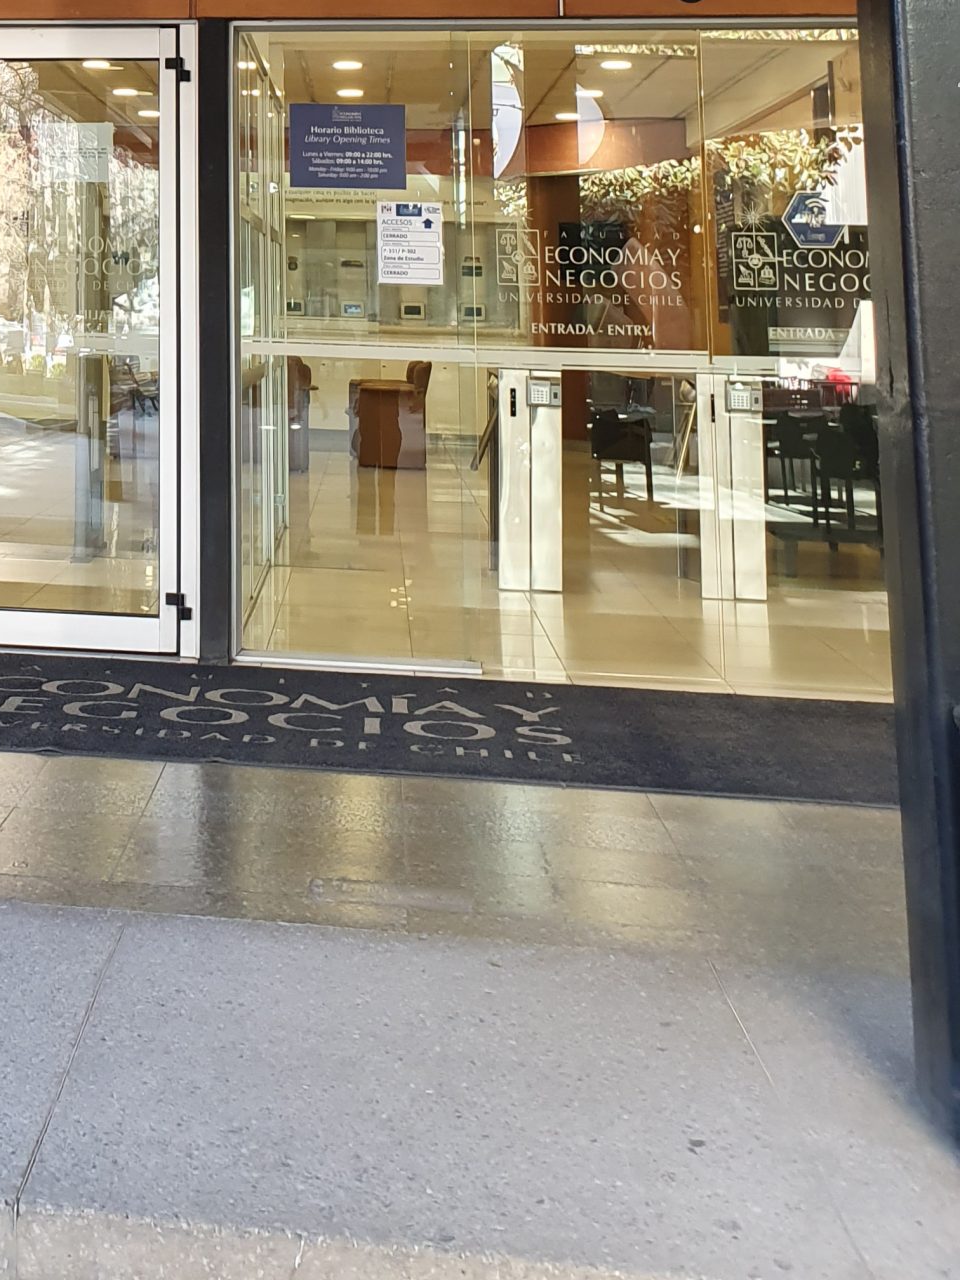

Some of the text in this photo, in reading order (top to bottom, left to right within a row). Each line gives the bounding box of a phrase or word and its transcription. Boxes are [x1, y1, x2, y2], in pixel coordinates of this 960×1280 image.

[310, 125, 384, 135] Horario Biblioteca
[304, 135, 390, 146] Library Opening Times
[544, 242, 681, 267] ECONOMÍA Y
[545, 269, 682, 290] NEGOCIOS
[612, 293, 631, 306] DE
[638, 294, 683, 307] CHILE
[735, 296, 845, 309] UNIVERSIDAD
[531, 322, 595, 336] ENTRADA
[769, 327, 835, 339] ENTRADA
